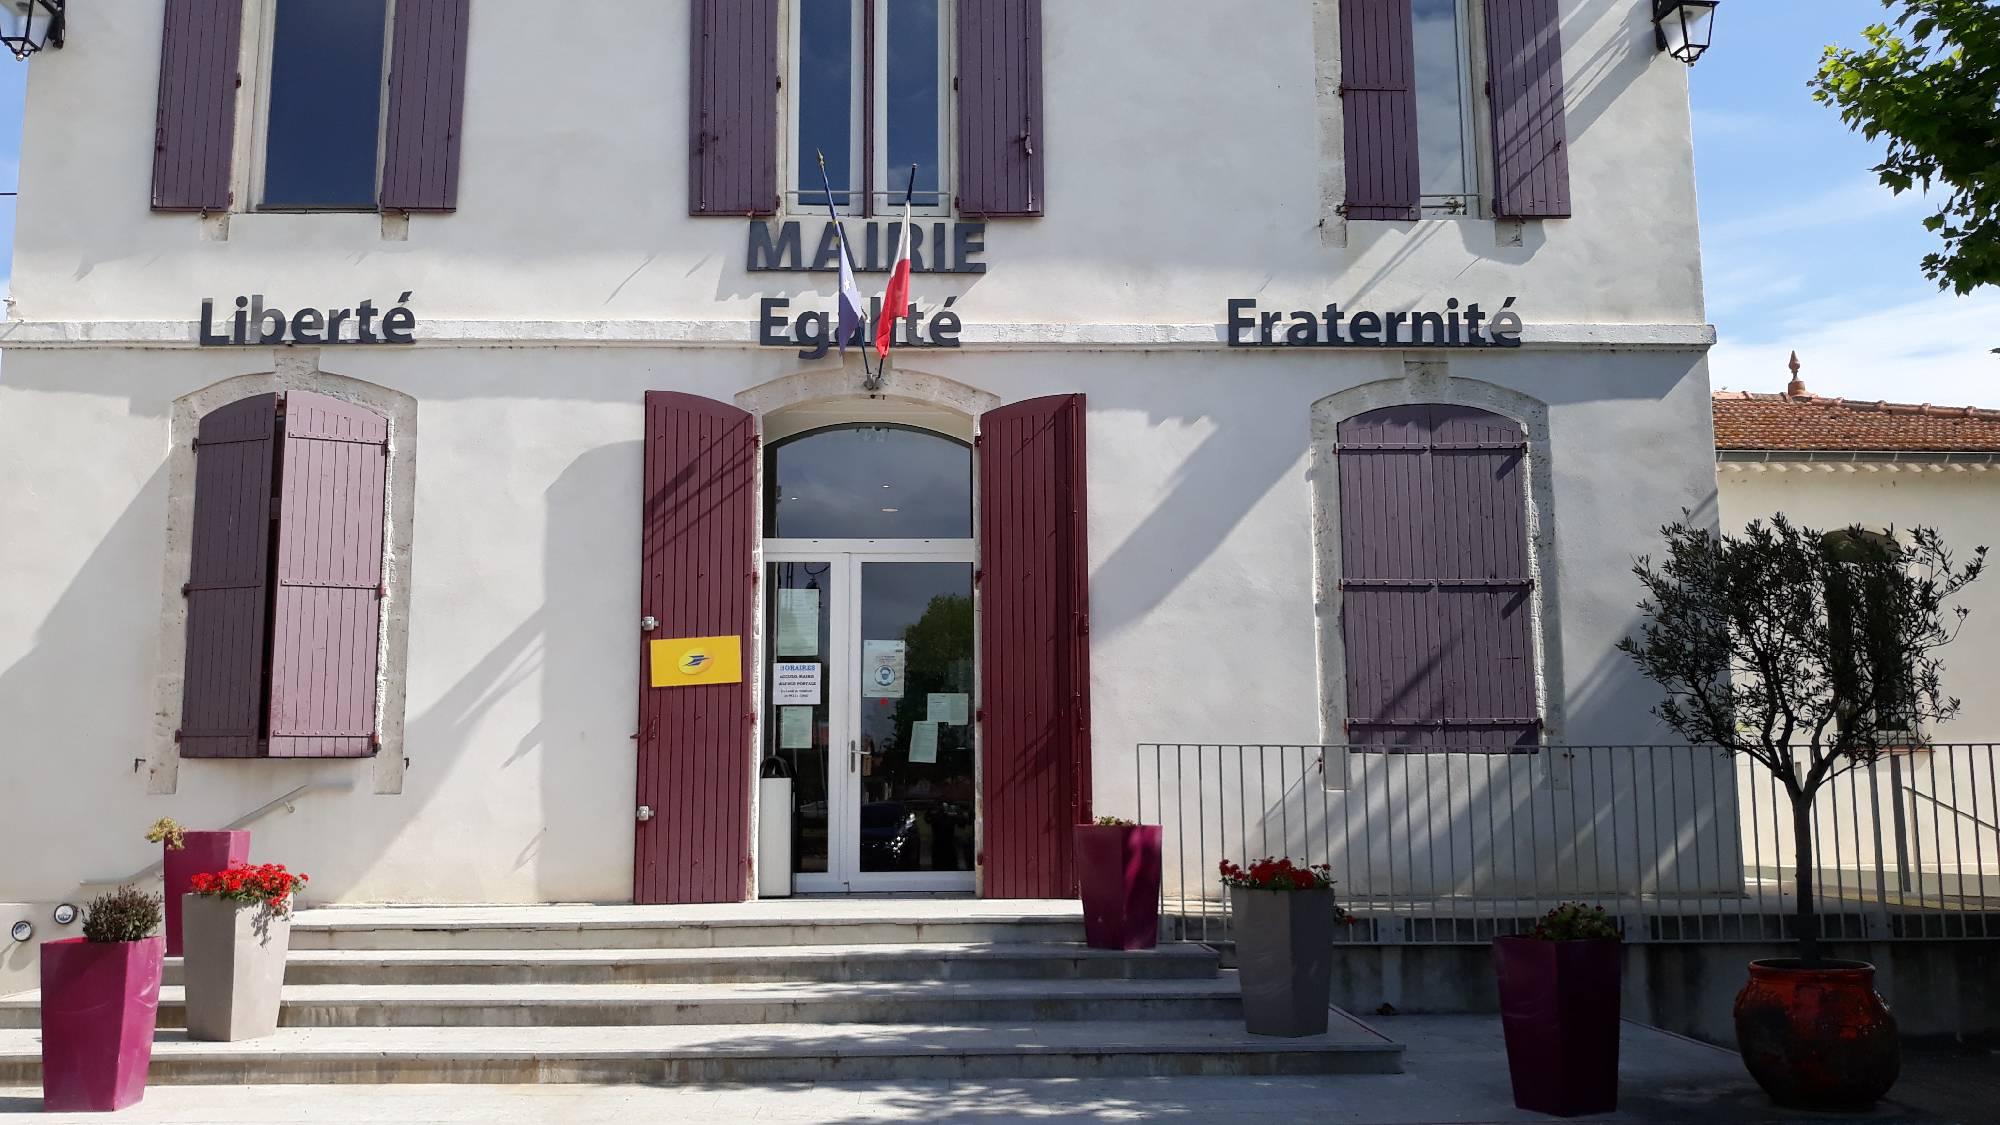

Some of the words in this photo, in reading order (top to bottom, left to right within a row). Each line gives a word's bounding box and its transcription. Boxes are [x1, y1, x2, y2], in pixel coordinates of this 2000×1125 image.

[747, 221, 987, 273] MAIRIE
[201, 291, 416, 345] Liberté
[1227, 297, 1523, 347] Fraternité
